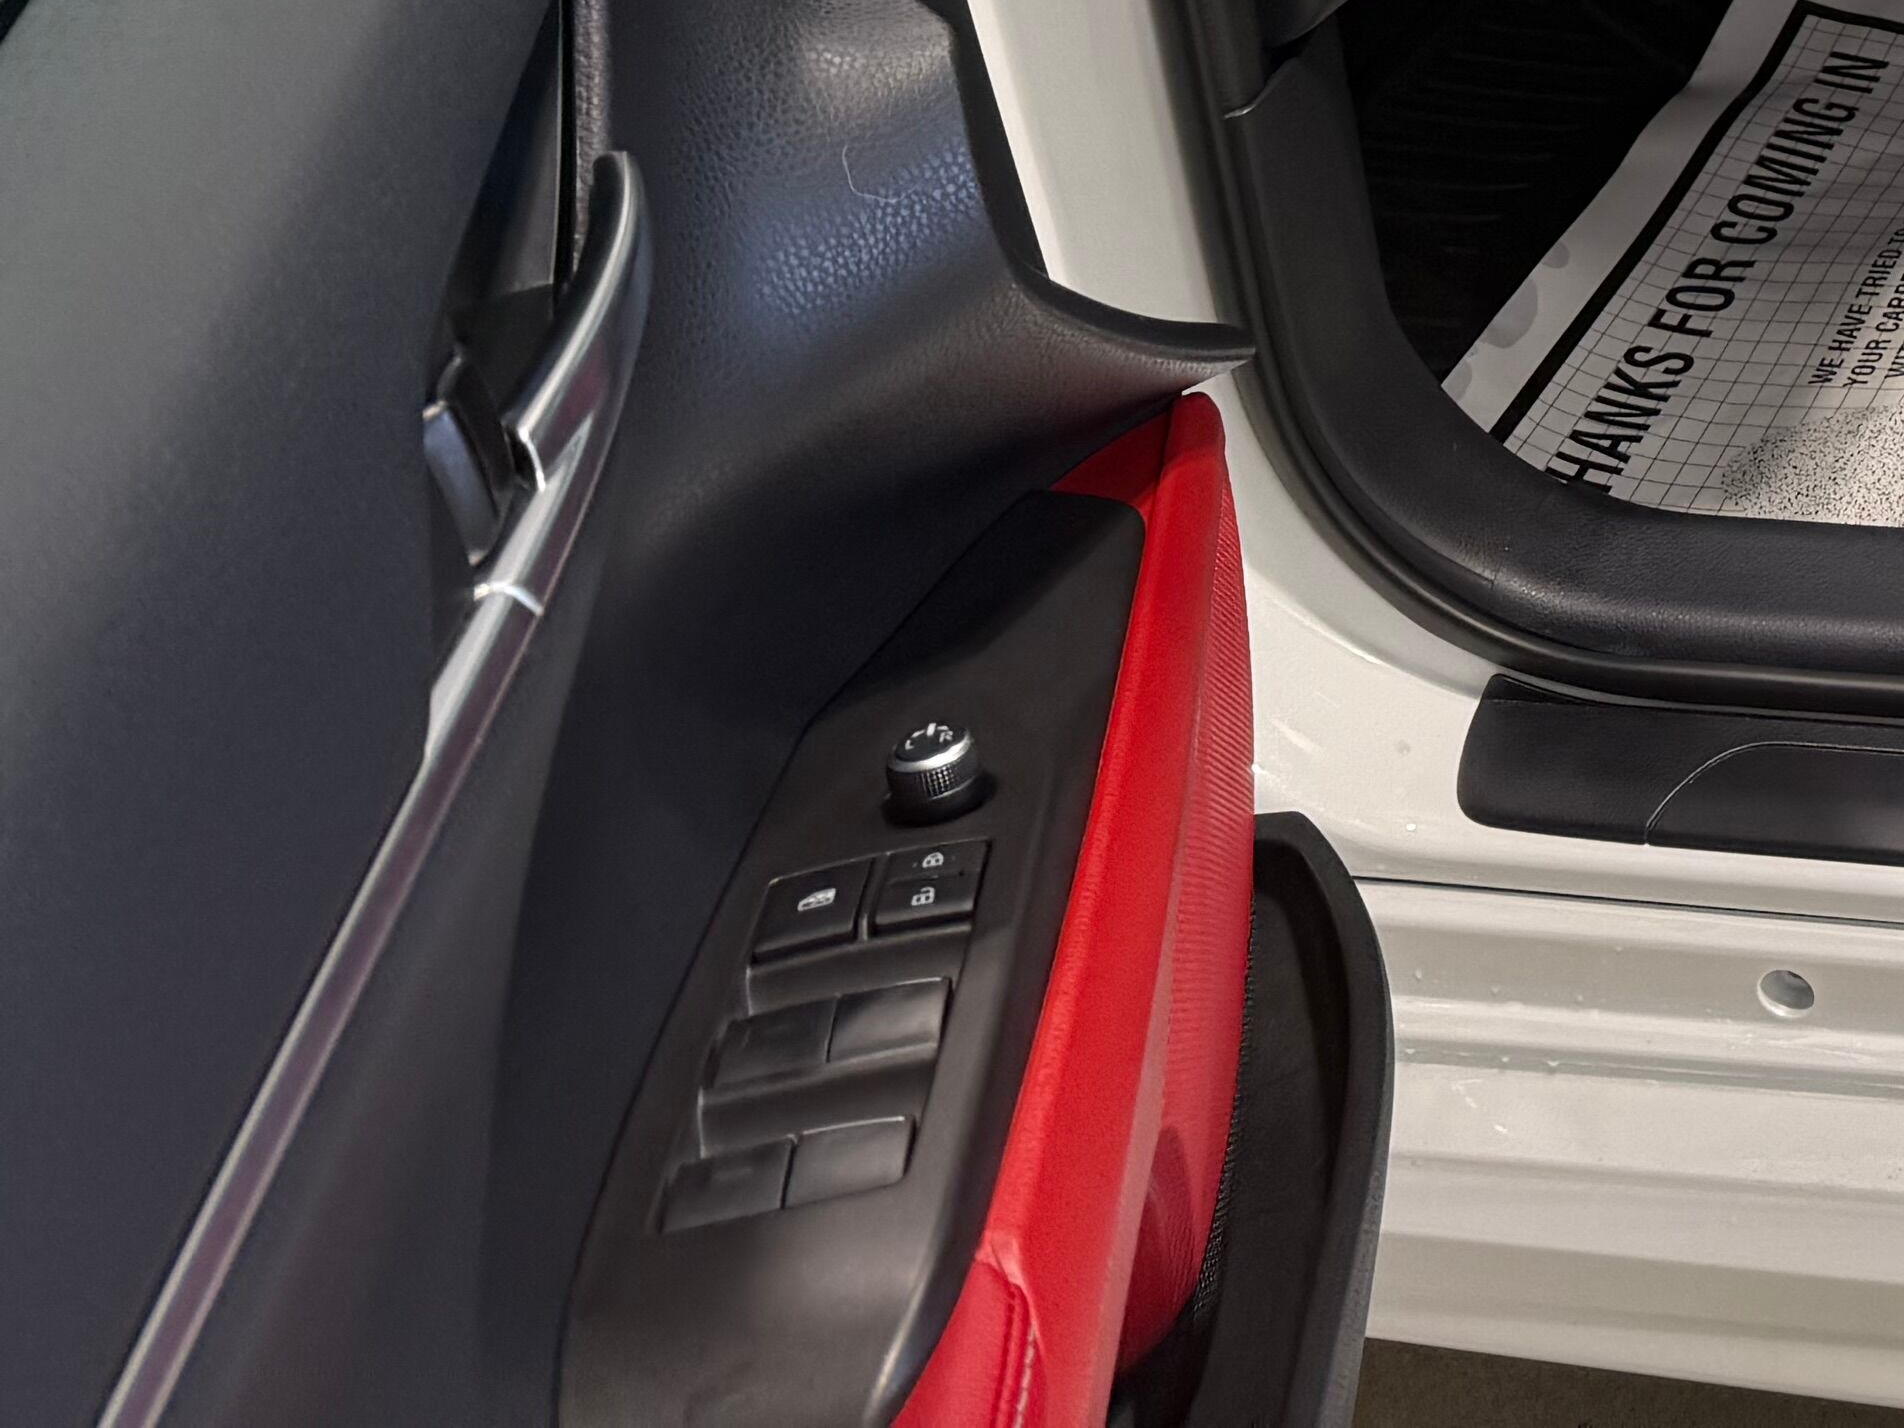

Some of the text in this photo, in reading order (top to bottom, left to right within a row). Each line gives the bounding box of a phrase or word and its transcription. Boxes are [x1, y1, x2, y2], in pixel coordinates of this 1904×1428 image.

[1545, 50, 1889, 493] HANKS FOR COMING IN
[1808, 356, 1845, 385] WE
[1828, 303, 1873, 352] HAVE
[1856, 249, 1902, 299] TRIED
[1843, 339, 1892, 388] YOUR
